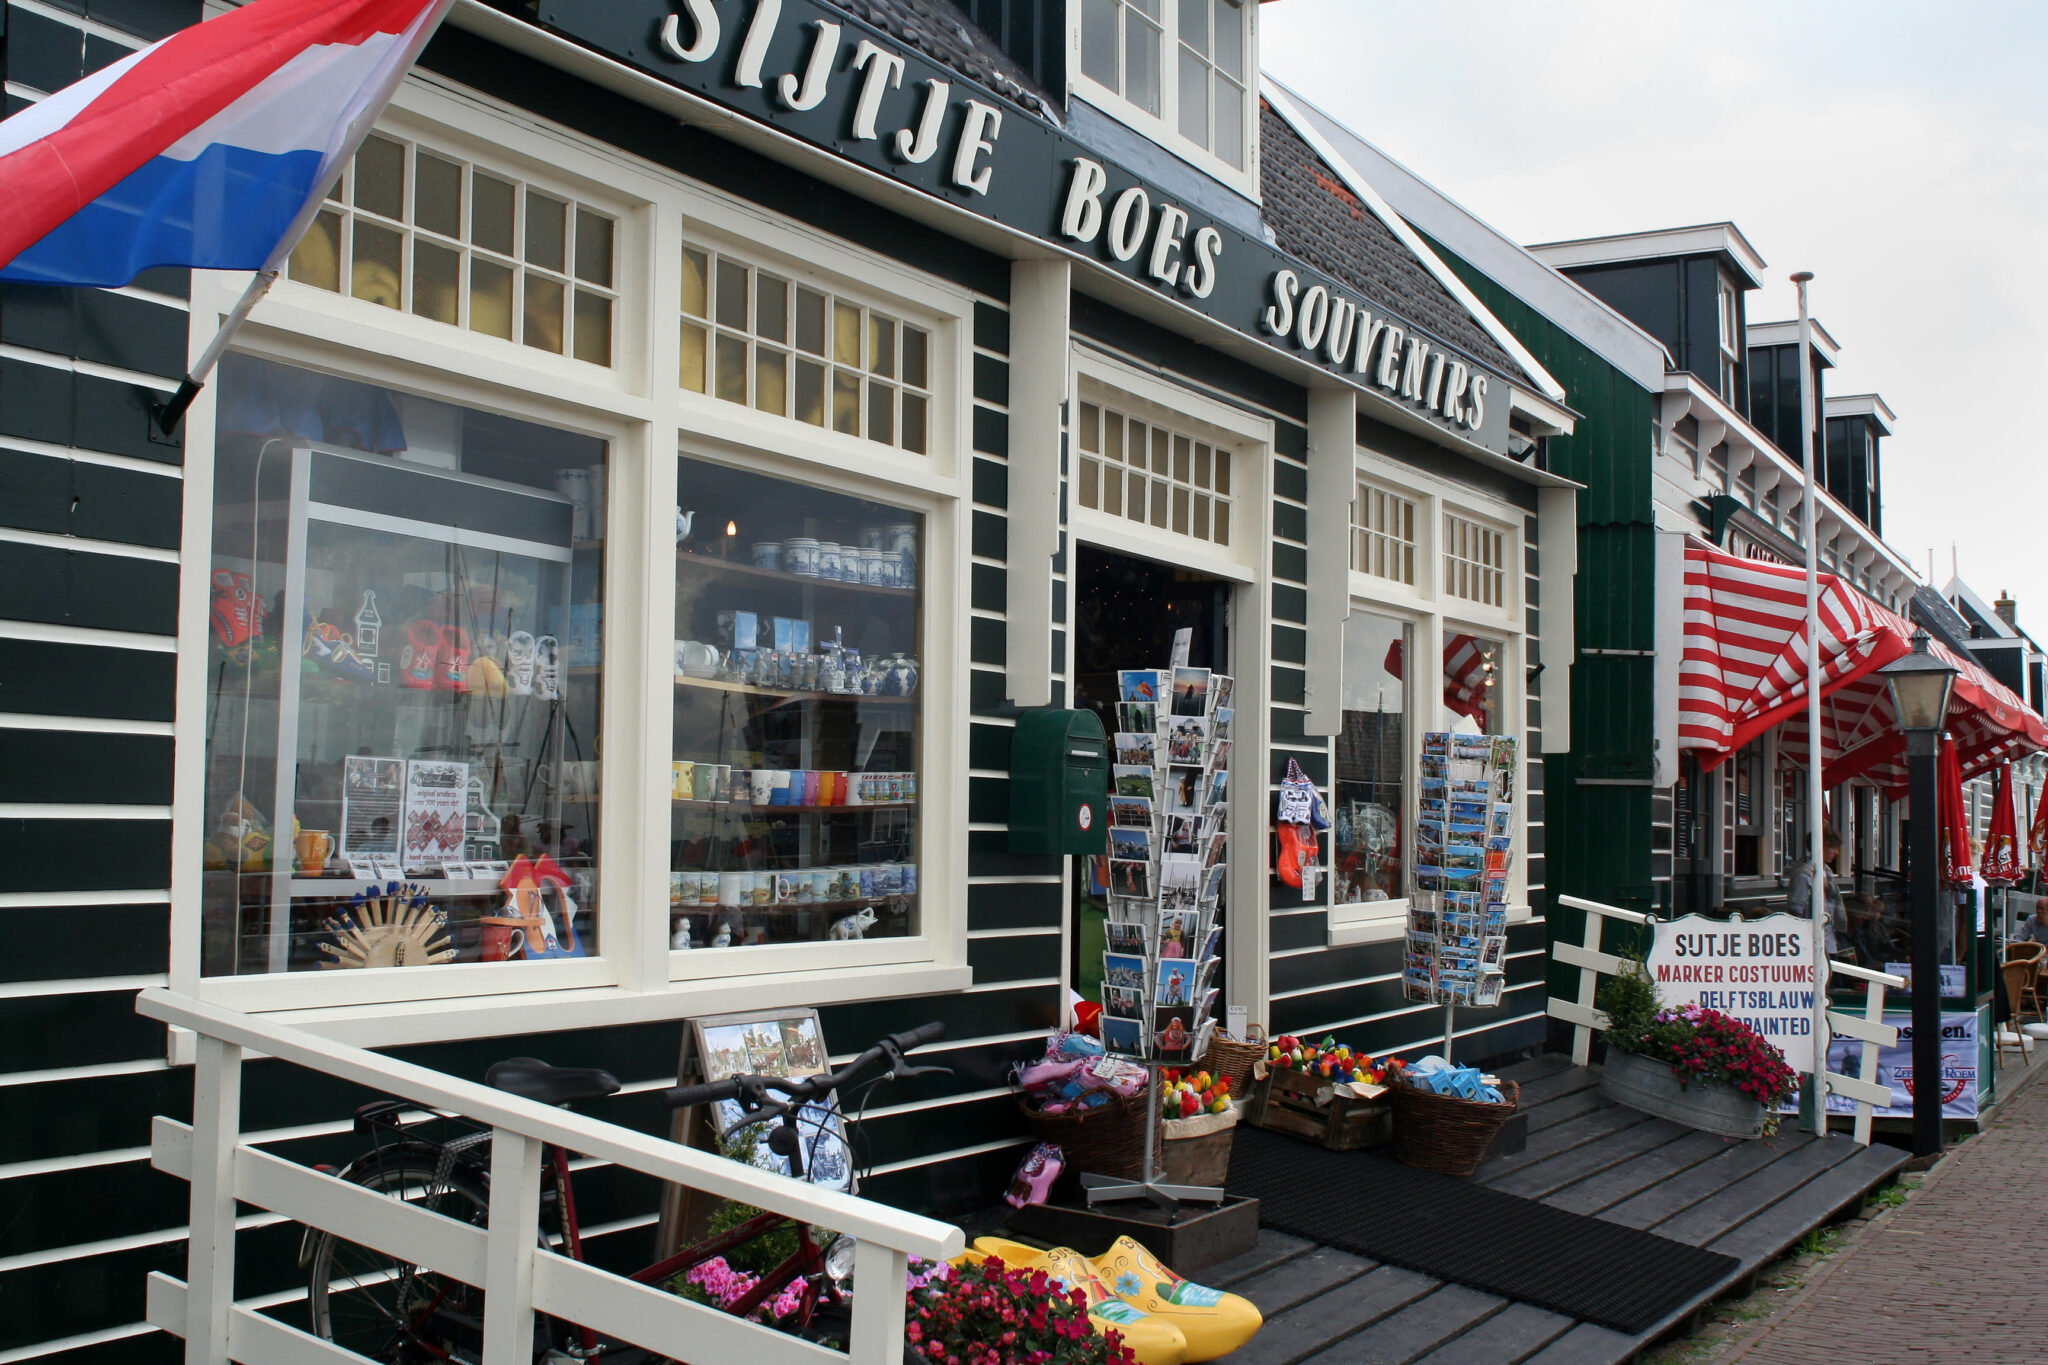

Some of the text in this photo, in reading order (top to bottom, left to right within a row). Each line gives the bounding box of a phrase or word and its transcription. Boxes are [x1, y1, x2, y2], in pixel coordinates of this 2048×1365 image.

[660, 0, 1488, 431] SIJTJE BOES SOUVENIRS
[1748, 933, 1801, 957] BOES
[1657, 964, 1814, 983] MARKER COSTUUMS
[1699, 990, 1814, 1009] DELFTSBLAUW
